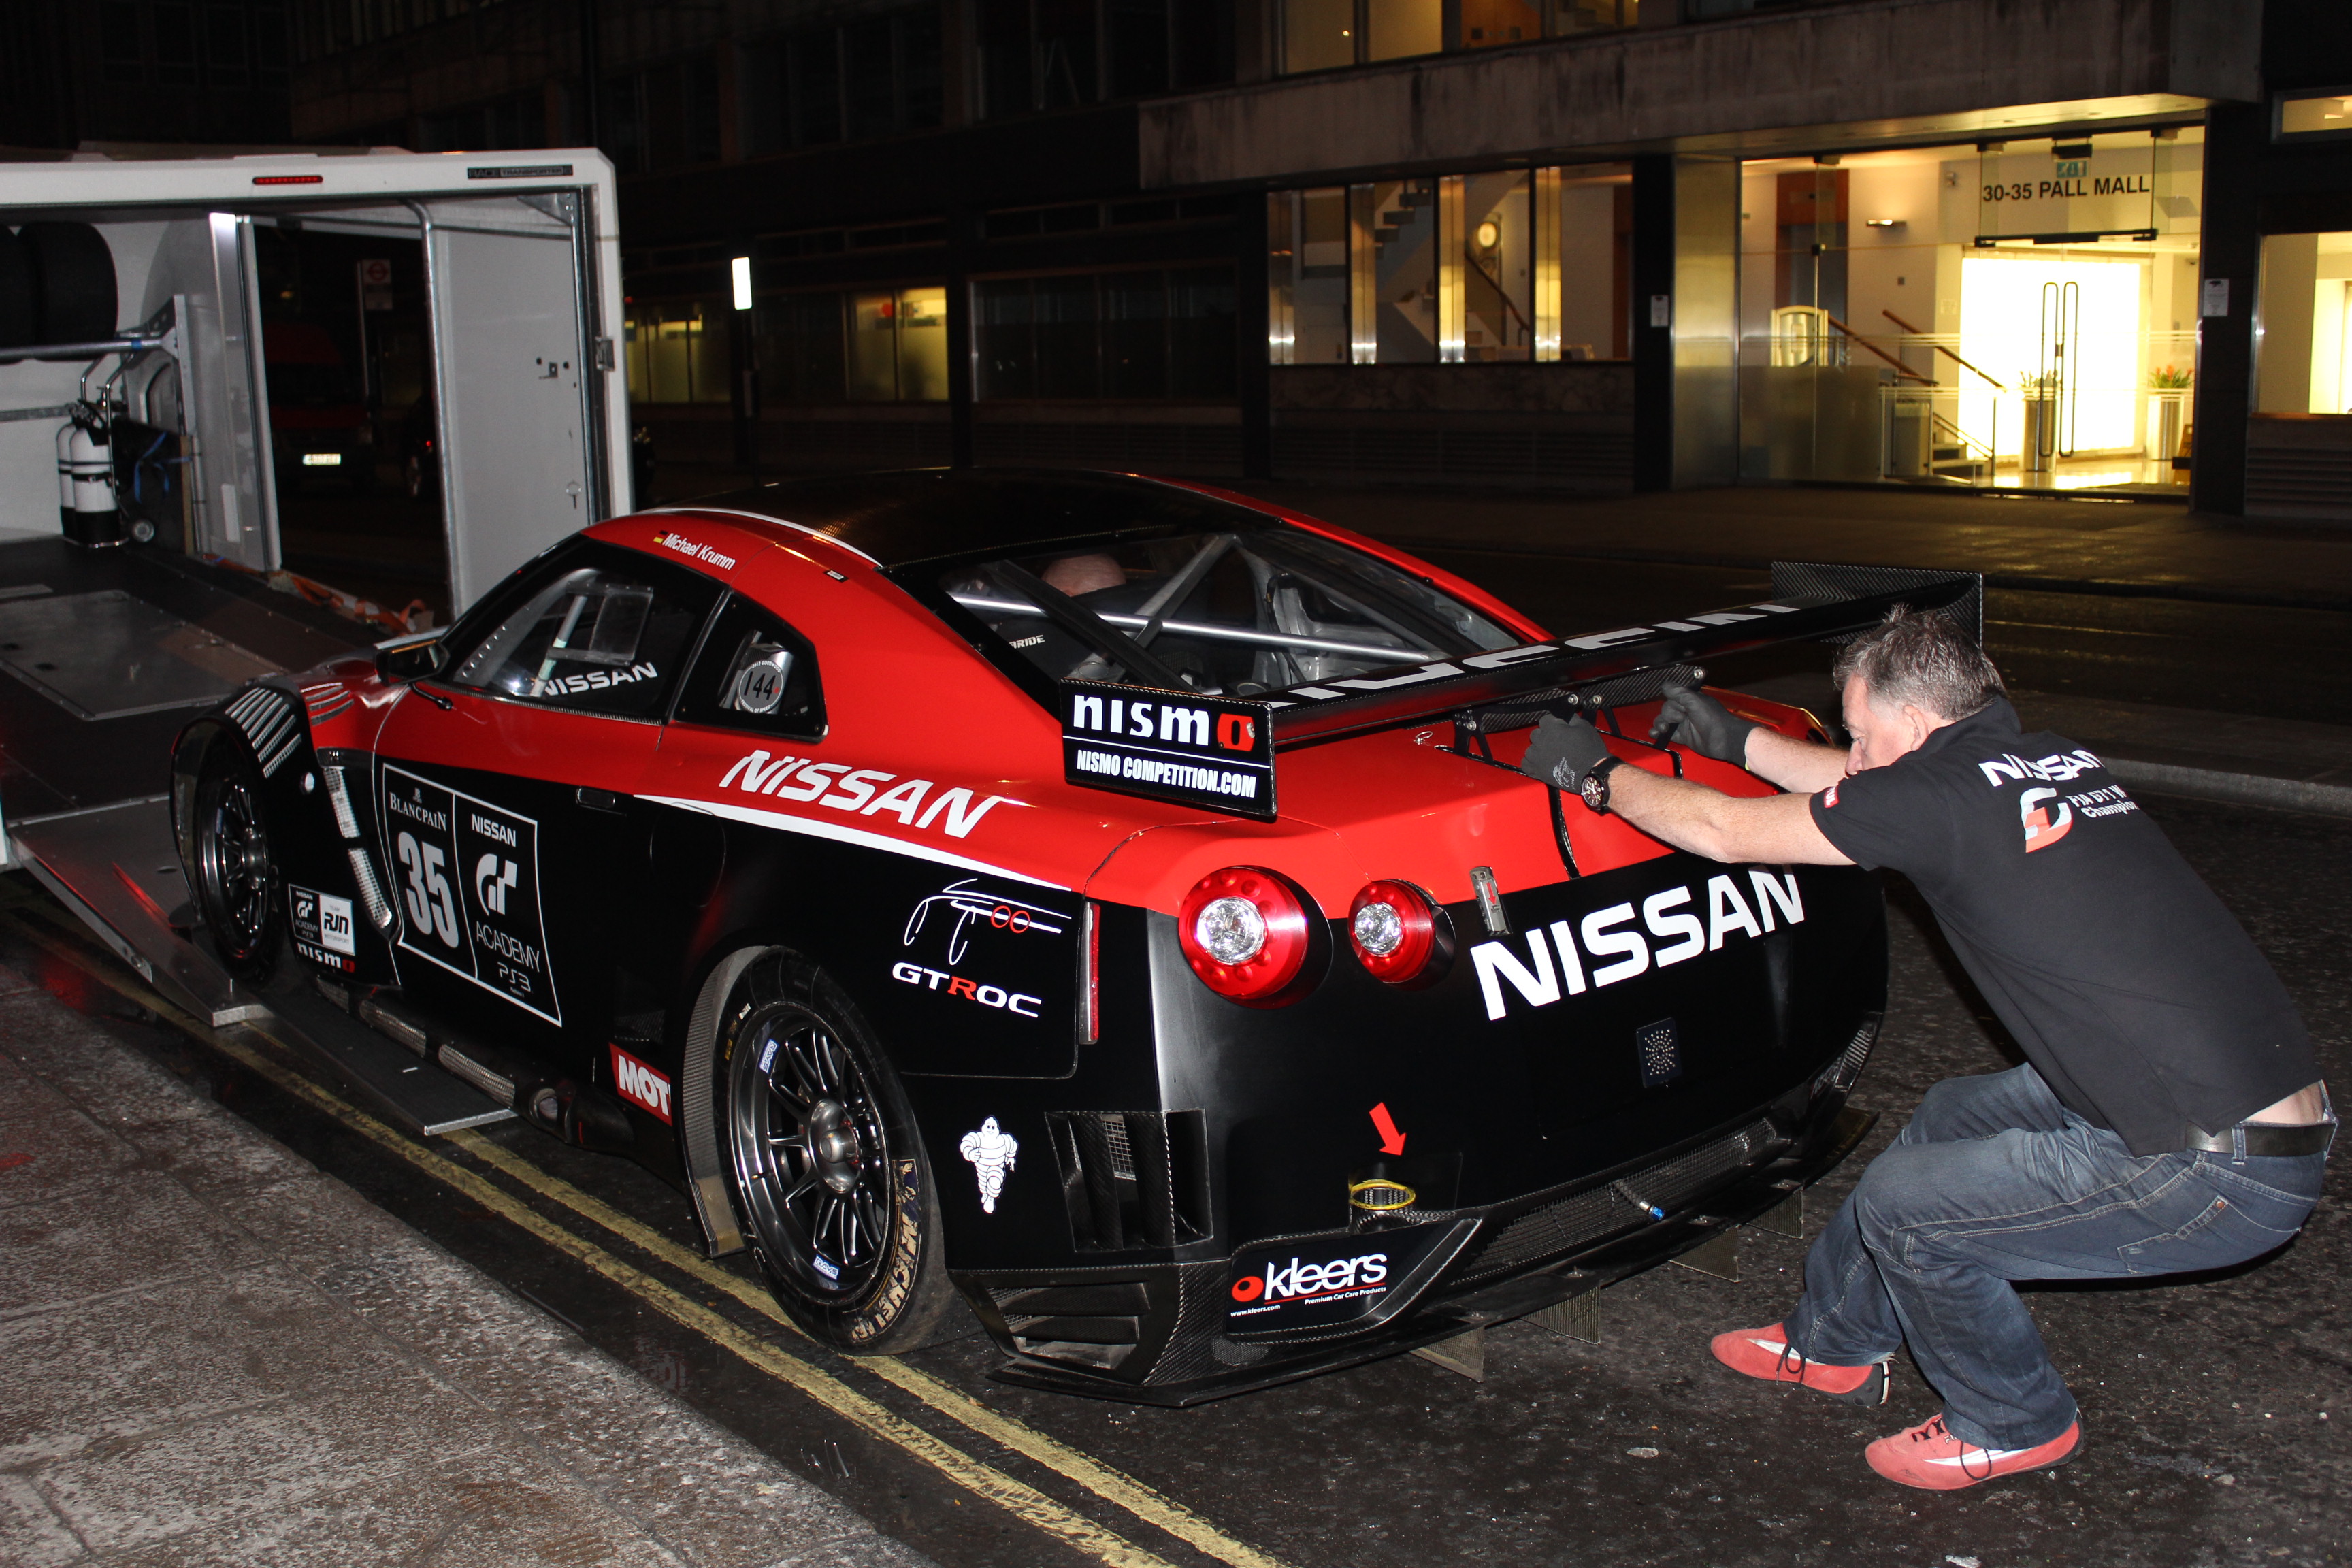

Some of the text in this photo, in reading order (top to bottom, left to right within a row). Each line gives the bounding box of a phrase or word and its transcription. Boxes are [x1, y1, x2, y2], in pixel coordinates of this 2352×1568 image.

[1982, 176, 2150, 202] 30-35 PALL MALL
[662, 532, 736, 570] Michael Krumm
[744, 671, 777, 700] 144
[718, 749, 1005, 839] NISSAN
[1077, 749, 1257, 798] NISMO COMPETITION.COM
[389, 791, 446, 832] BLANCPAIN
[2065, 794, 2095, 808] FIA
[471, 813, 517, 848] NISSAN
[397, 831, 459, 949] 35
[476, 920, 540, 973] ACADEMY
[1469, 864, 1805, 1022] NISSAN
[892, 962, 1042, 1018] GTROC
[618, 1054, 671, 1117] MOT
[1230, 1304, 1281, 1318] www.kleers.com
[1304, 1296, 1333, 1305] Premium
[1360, 1286, 1387, 1296] Products
